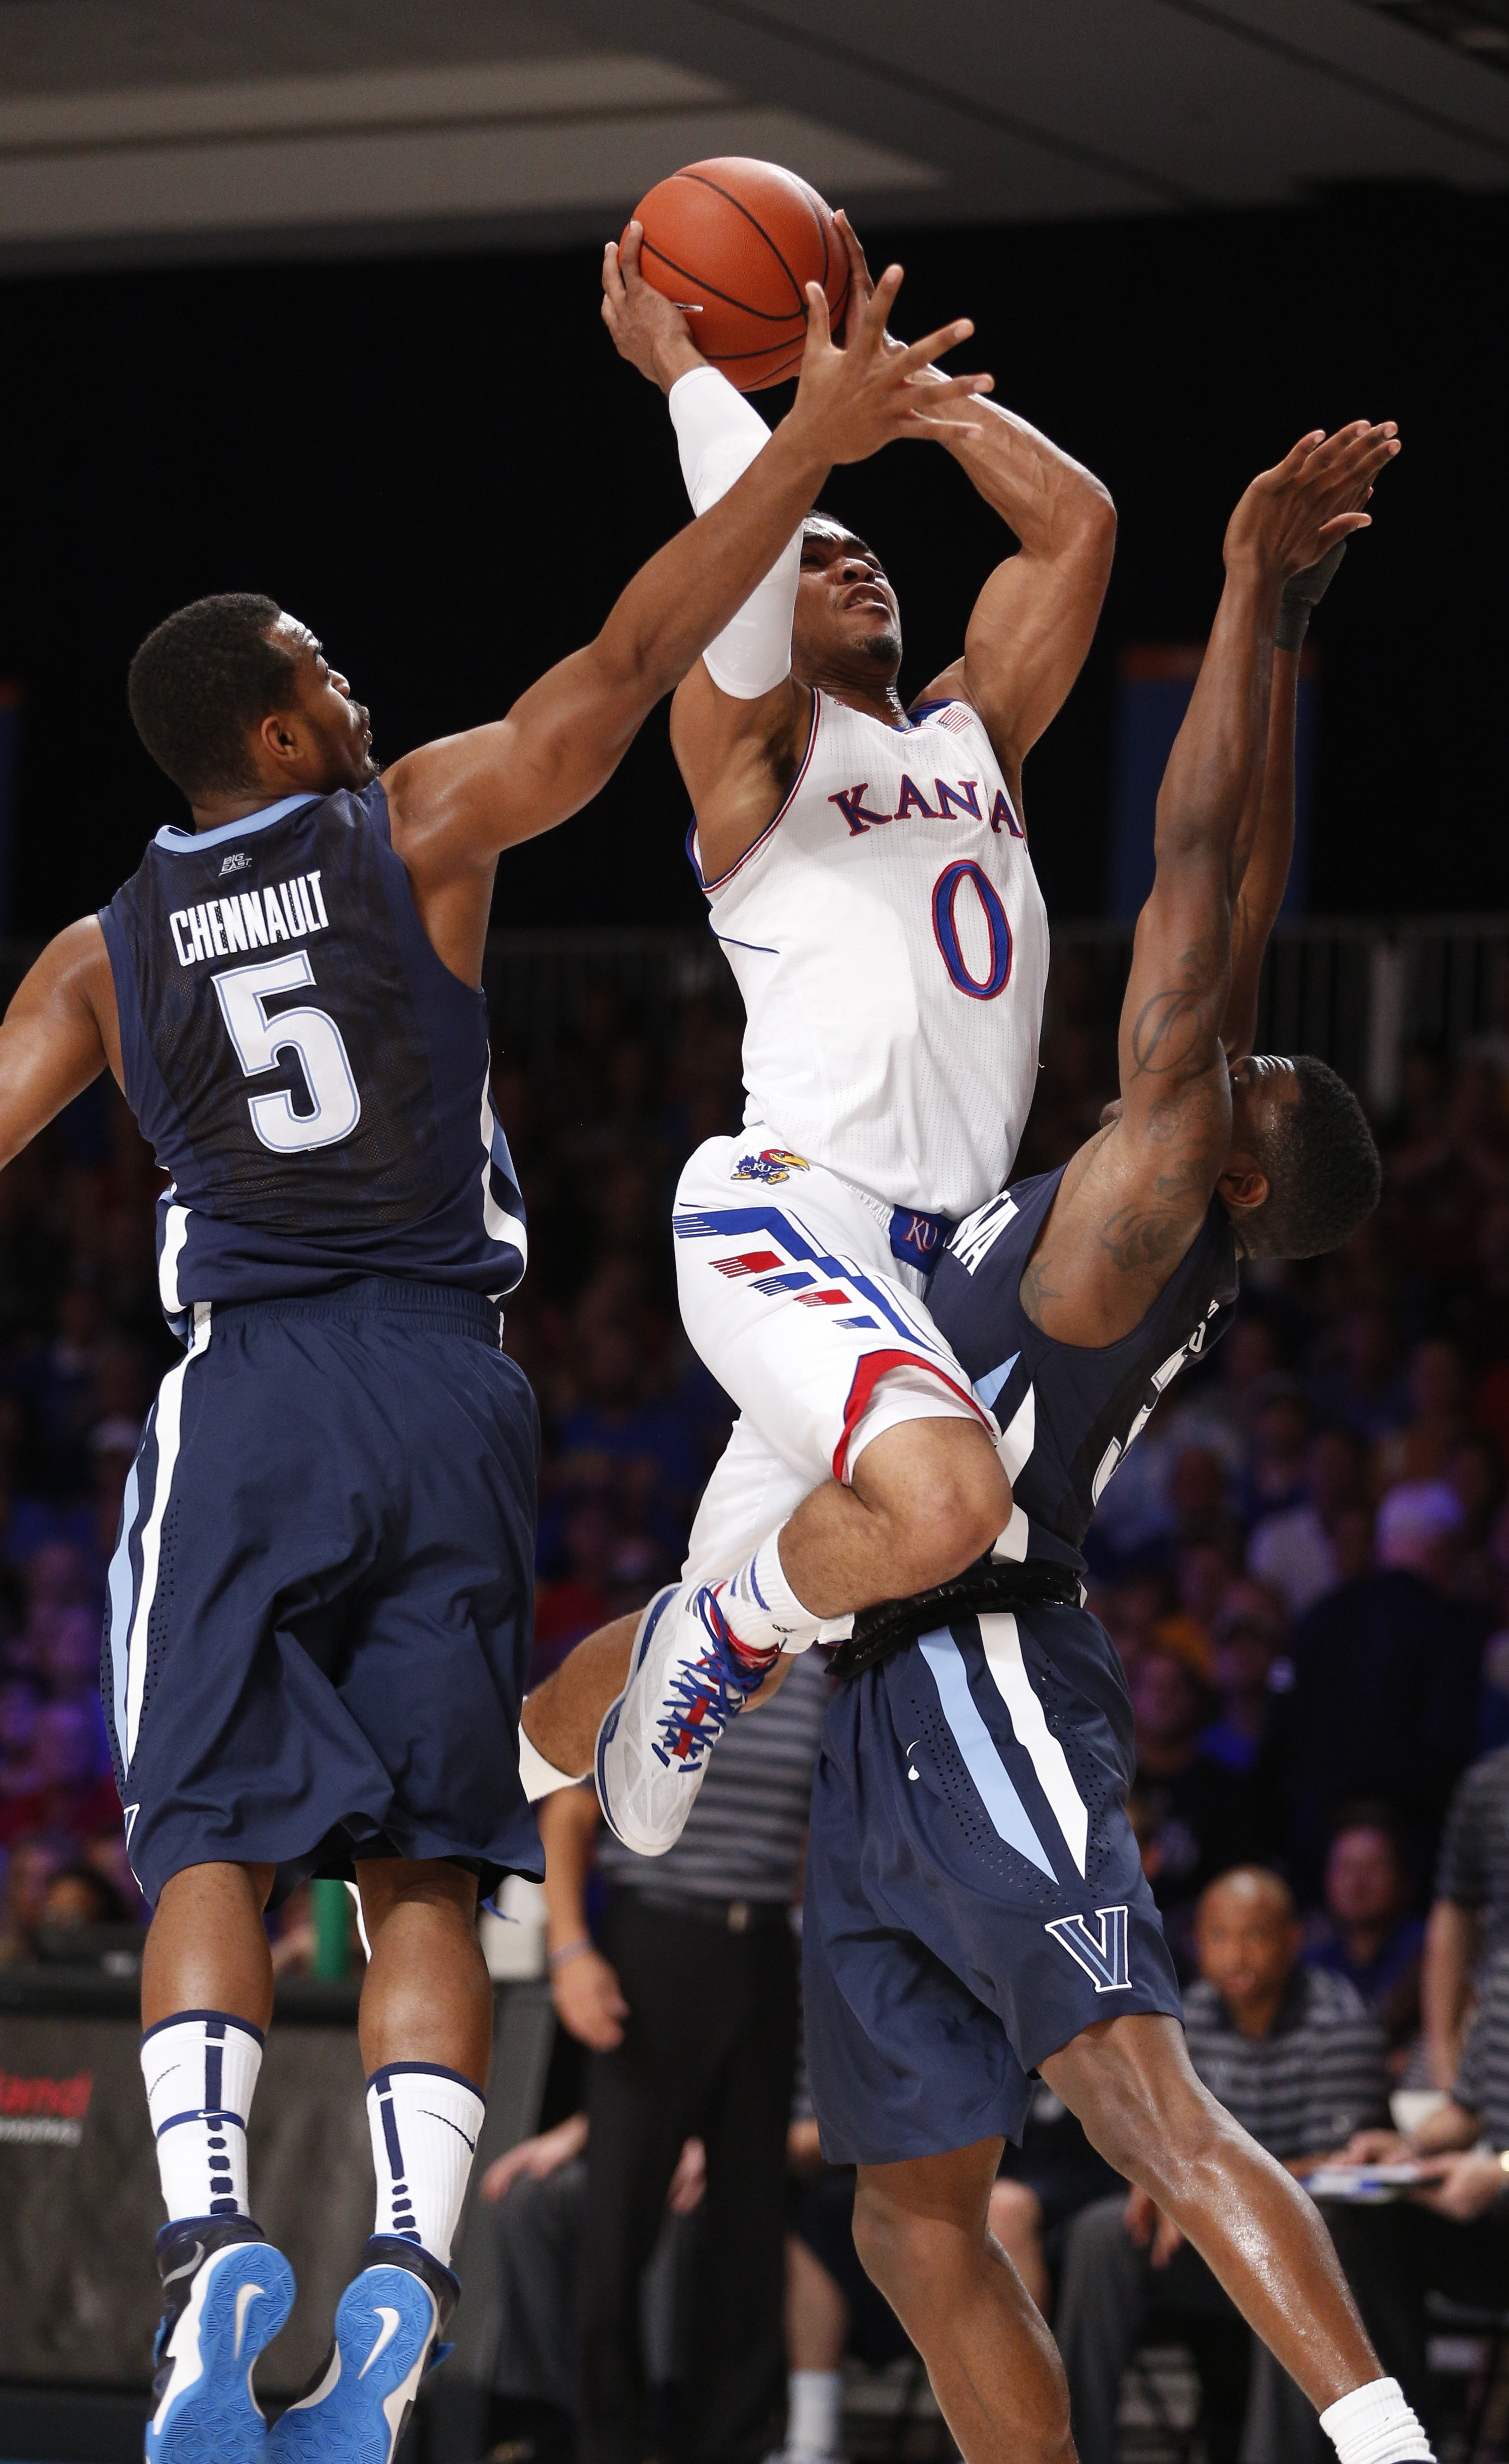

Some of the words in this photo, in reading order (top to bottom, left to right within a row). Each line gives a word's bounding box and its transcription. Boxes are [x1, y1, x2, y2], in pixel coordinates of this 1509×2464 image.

[221, 858, 252, 872] EAST
[223, 853, 244, 865] BIG
[170, 871, 329, 966] CHENNAULT
[932, 859, 1013, 1000] 0
[211, 950, 361, 1153] 5
[751, 1163, 771, 1173] KU
[903, 1214, 938, 1253] KU
[1044, 1905, 1133, 1993] V
